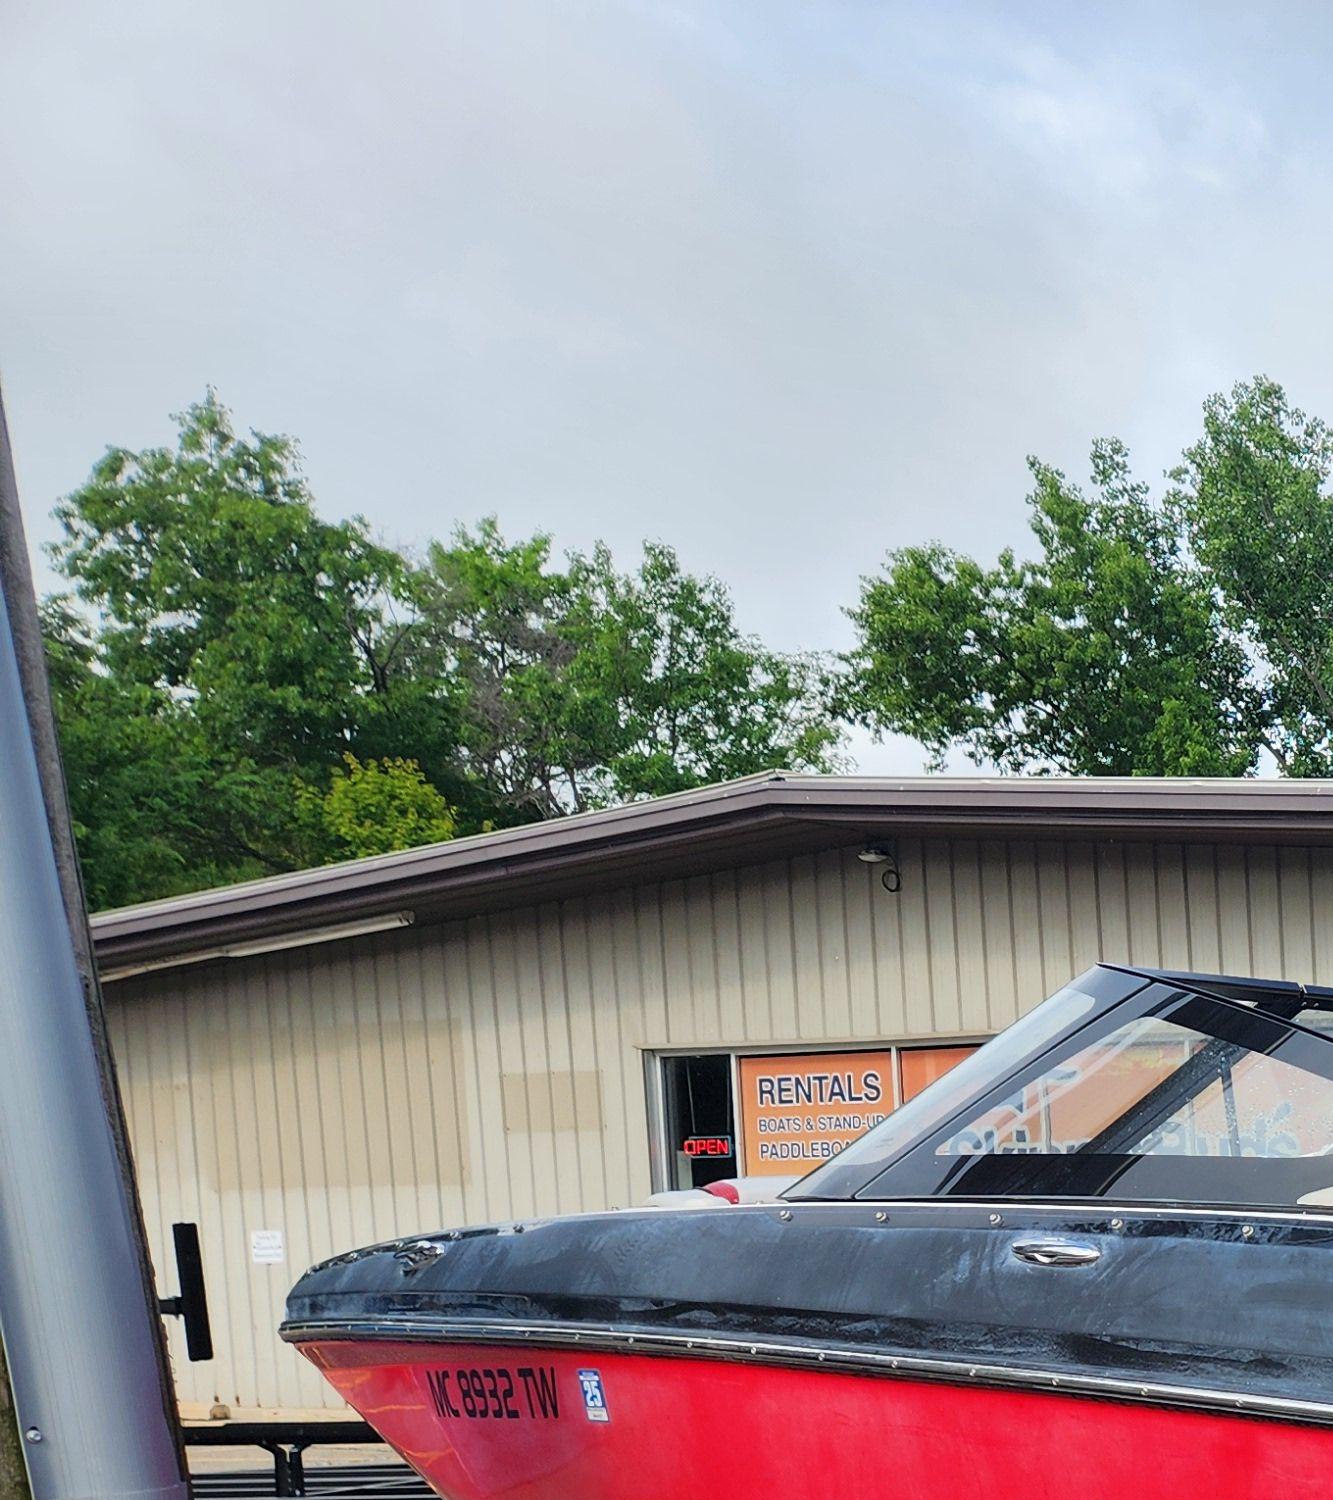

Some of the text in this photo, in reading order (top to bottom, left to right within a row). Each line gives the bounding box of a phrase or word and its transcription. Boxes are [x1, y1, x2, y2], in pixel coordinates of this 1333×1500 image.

[757, 1073, 882, 1105] RENTALS
[759, 1118, 801, 1132] BOATS
[805, 1118, 814, 1131] &
[683, 1139, 728, 1156] OPEN
[427, 1367, 559, 1418] MC 8932 TW
[583, 1380, 603, 1407] 25
